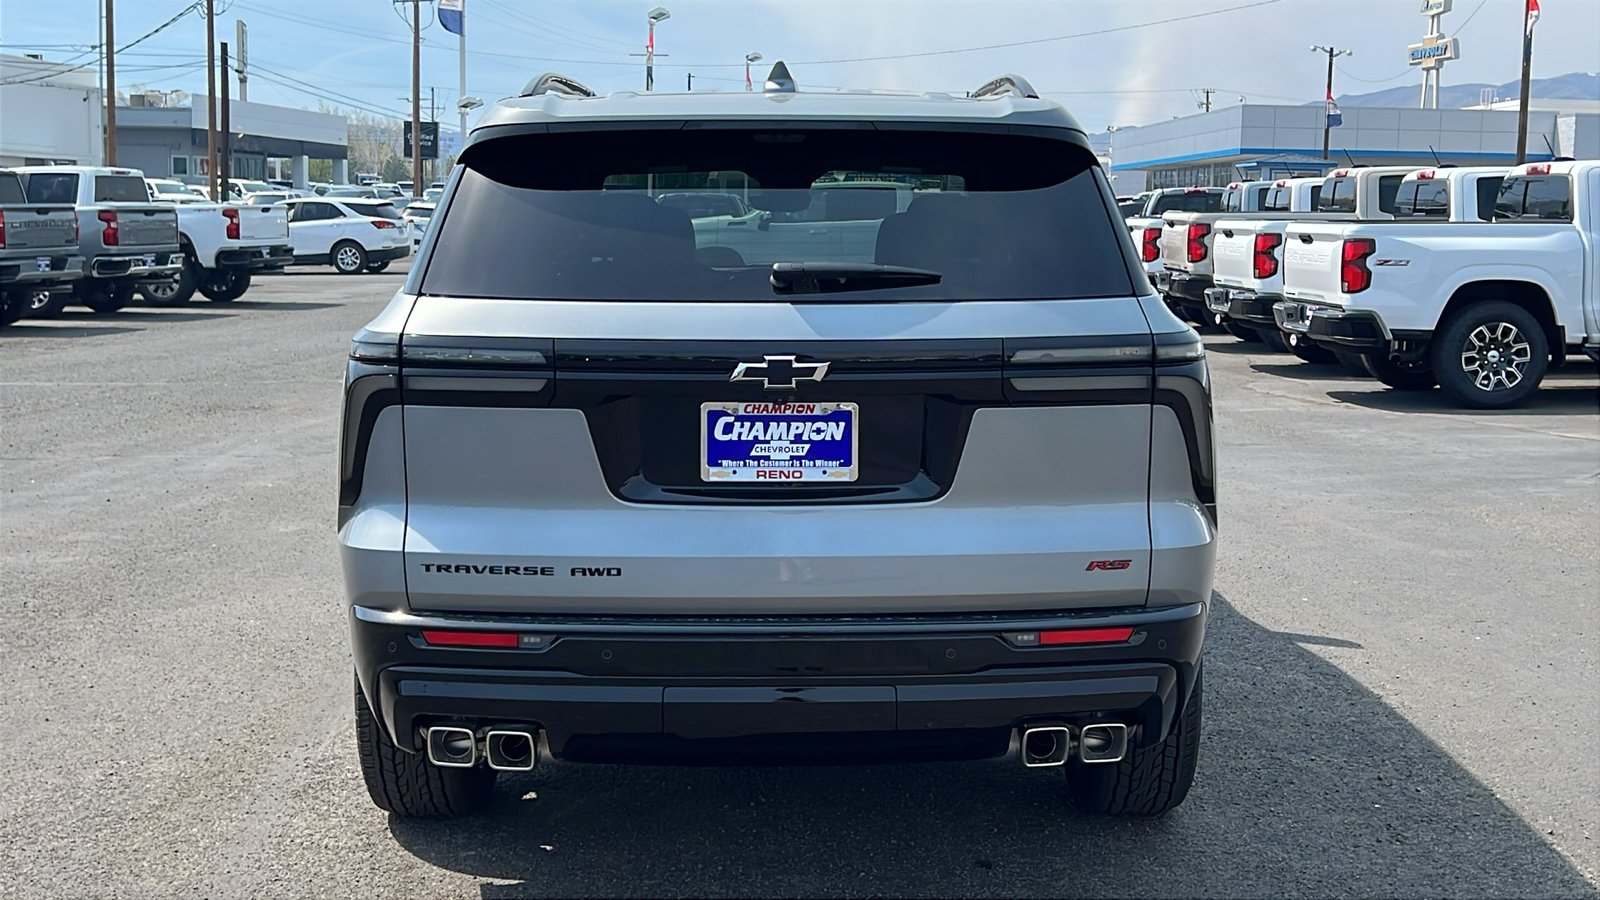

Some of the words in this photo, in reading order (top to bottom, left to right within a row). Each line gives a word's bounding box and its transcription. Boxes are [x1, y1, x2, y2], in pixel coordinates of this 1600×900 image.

[743, 402, 816, 414] CHAMPION
[713, 416, 846, 441] CHAMPION
[754, 445, 806, 454] CHEVROLET
[745, 459, 758, 467] The
[759, 459, 792, 467] Customer
[801, 459, 814, 467] The
[756, 469, 803, 479] RENO
[420, 563, 555, 576] TRAVERSE
[570, 566, 622, 577] AWD
[1085, 559, 1132, 571] RS
